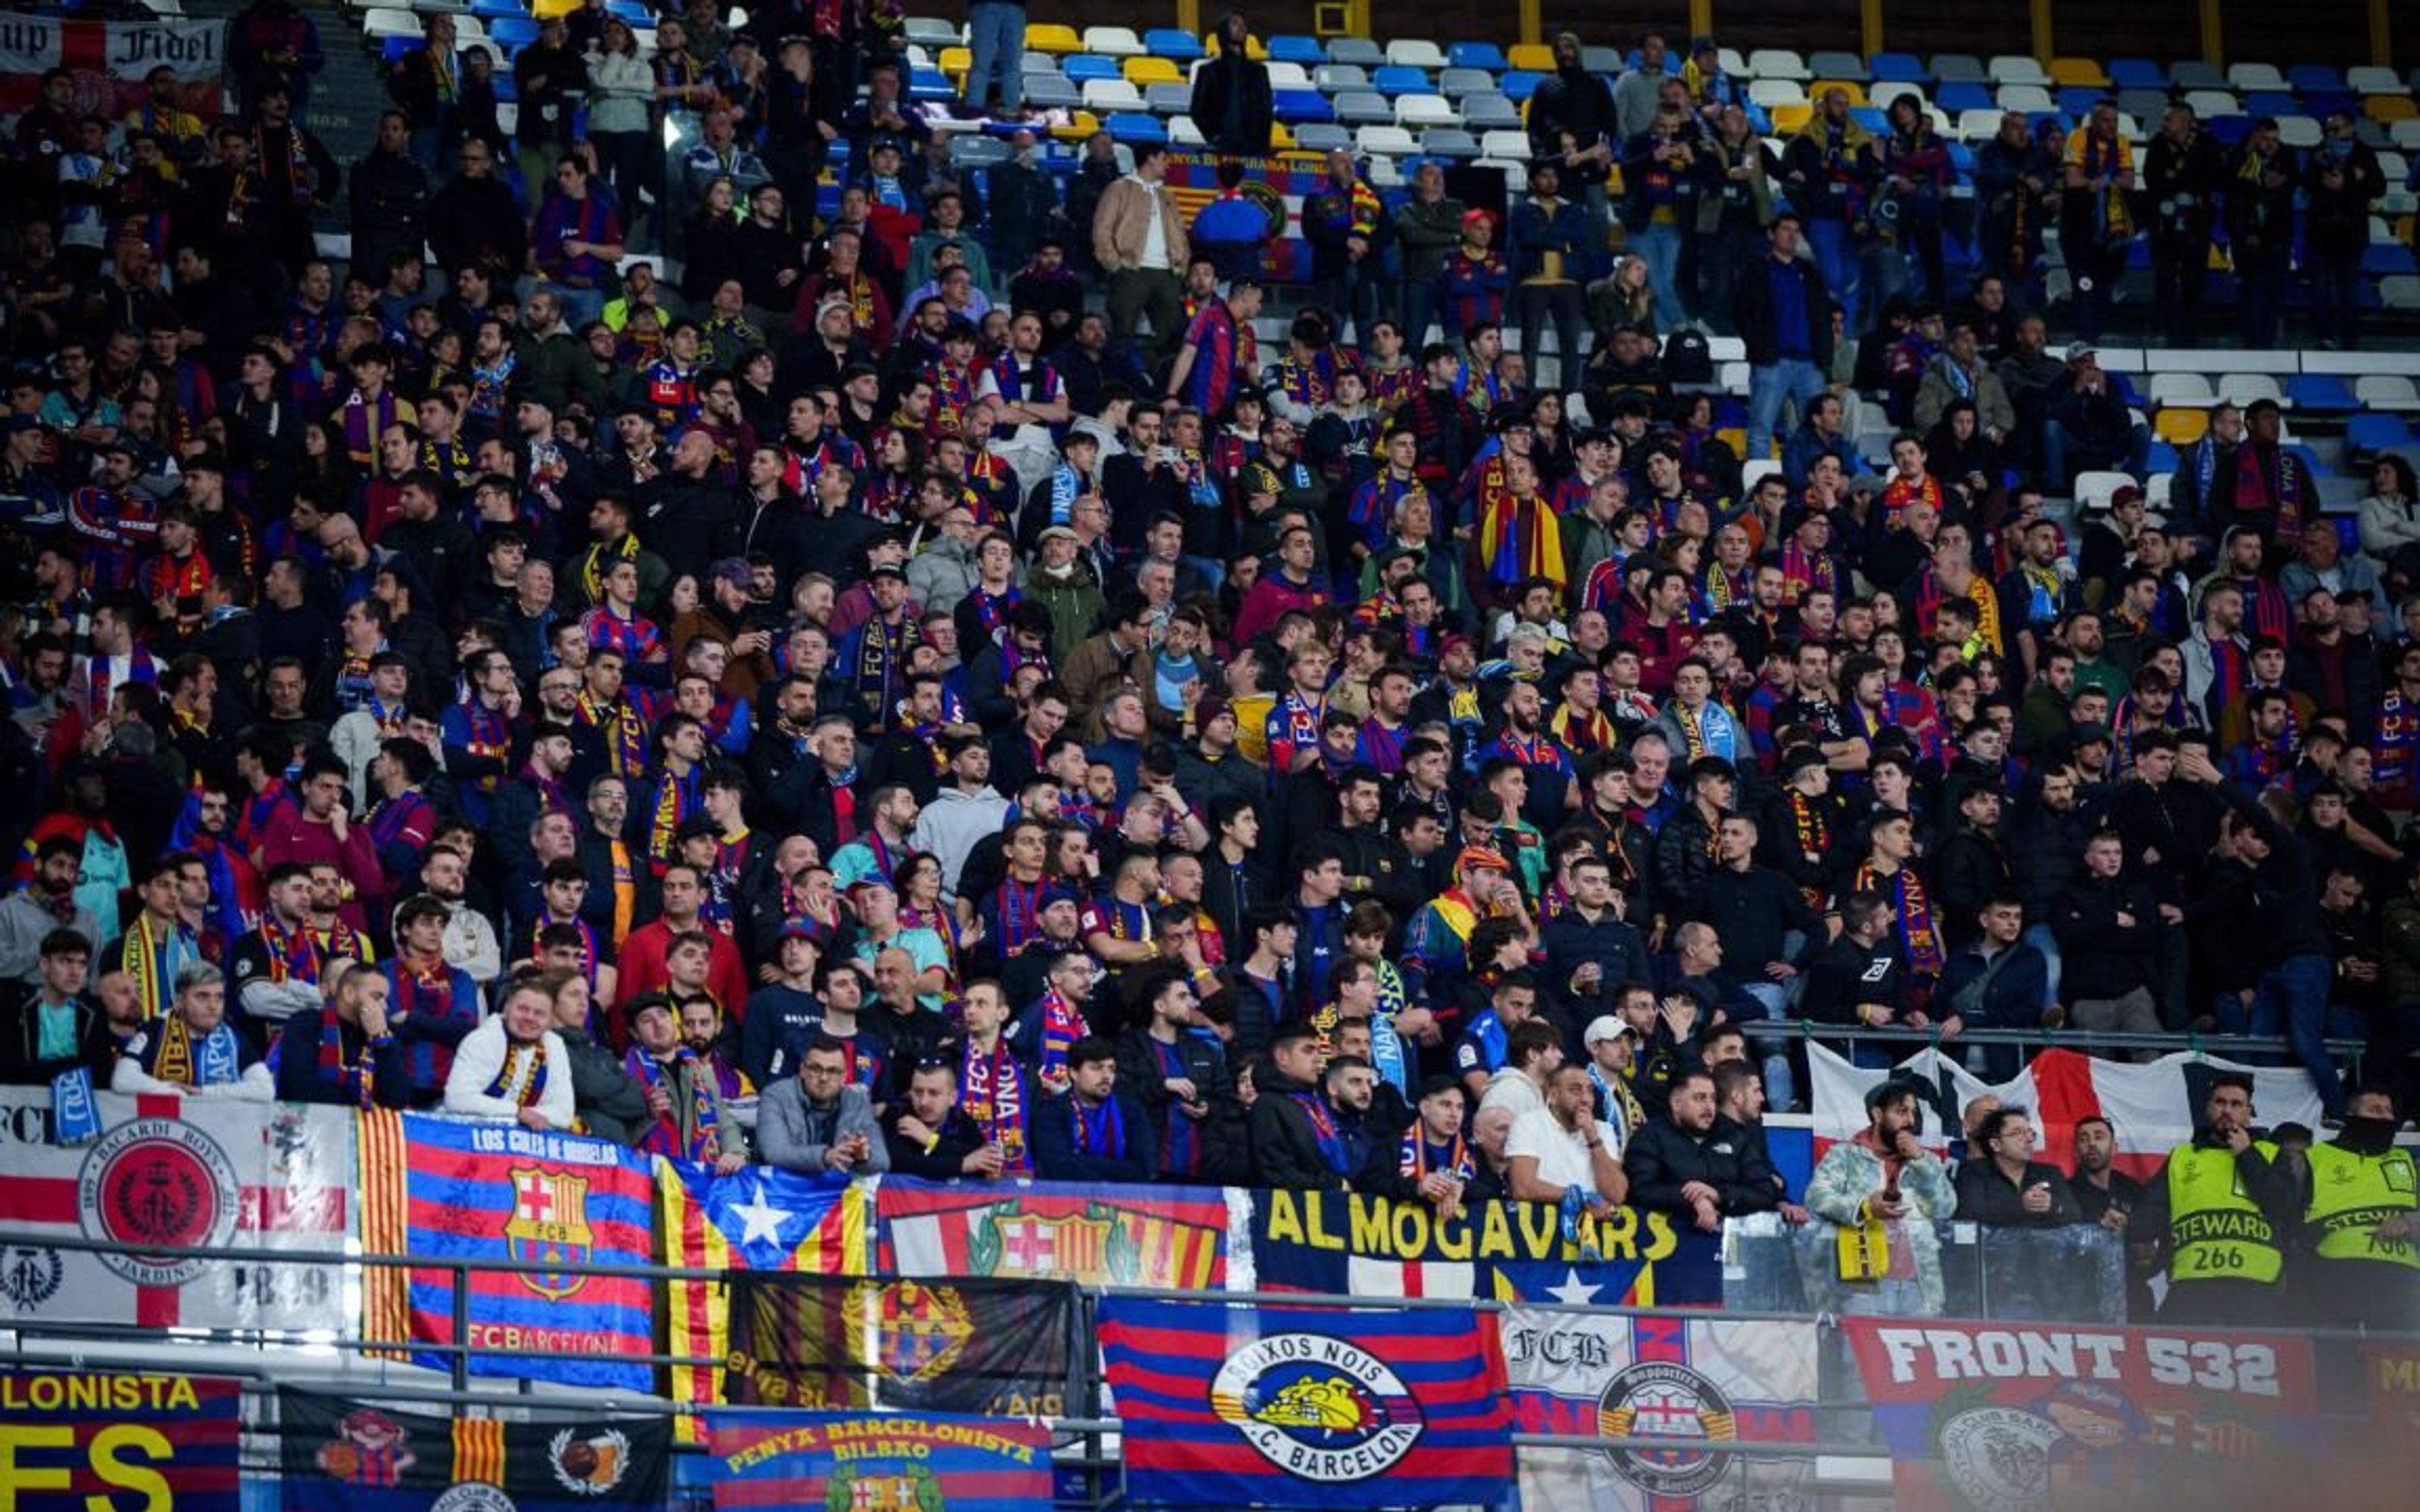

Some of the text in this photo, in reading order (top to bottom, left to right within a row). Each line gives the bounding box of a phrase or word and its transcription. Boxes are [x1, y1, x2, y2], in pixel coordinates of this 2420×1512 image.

[115, 28, 213, 65] Fidel
[97, 1123, 219, 1168] BACARDI BOYS
[473, 1129, 505, 1151] LOS
[535, 1222, 566, 1241] FCB
[1268, 1188, 1678, 1262] ALMOGAVRS
[2171, 1213, 2273, 1247] STEWARD
[2324, 1210, 2400, 1232] STEW
[2194, 1247, 2245, 1271] 266
[504, 1327, 618, 1353] BARCELONA
[1511, 1328, 1610, 1366] FCB
[1324, 1341, 1384, 1383] NOIS
[1877, 1327, 2281, 1396] FRONT 532
[2380, 1359, 2420, 1393] M
[2, 1374, 200, 1411] LONISTA
[726, 1419, 1035, 1474] PENYA BARCELONISTA
[833, 1439, 930, 1461] BILBAO
[1289, 1424, 1413, 1476] BARCELON
